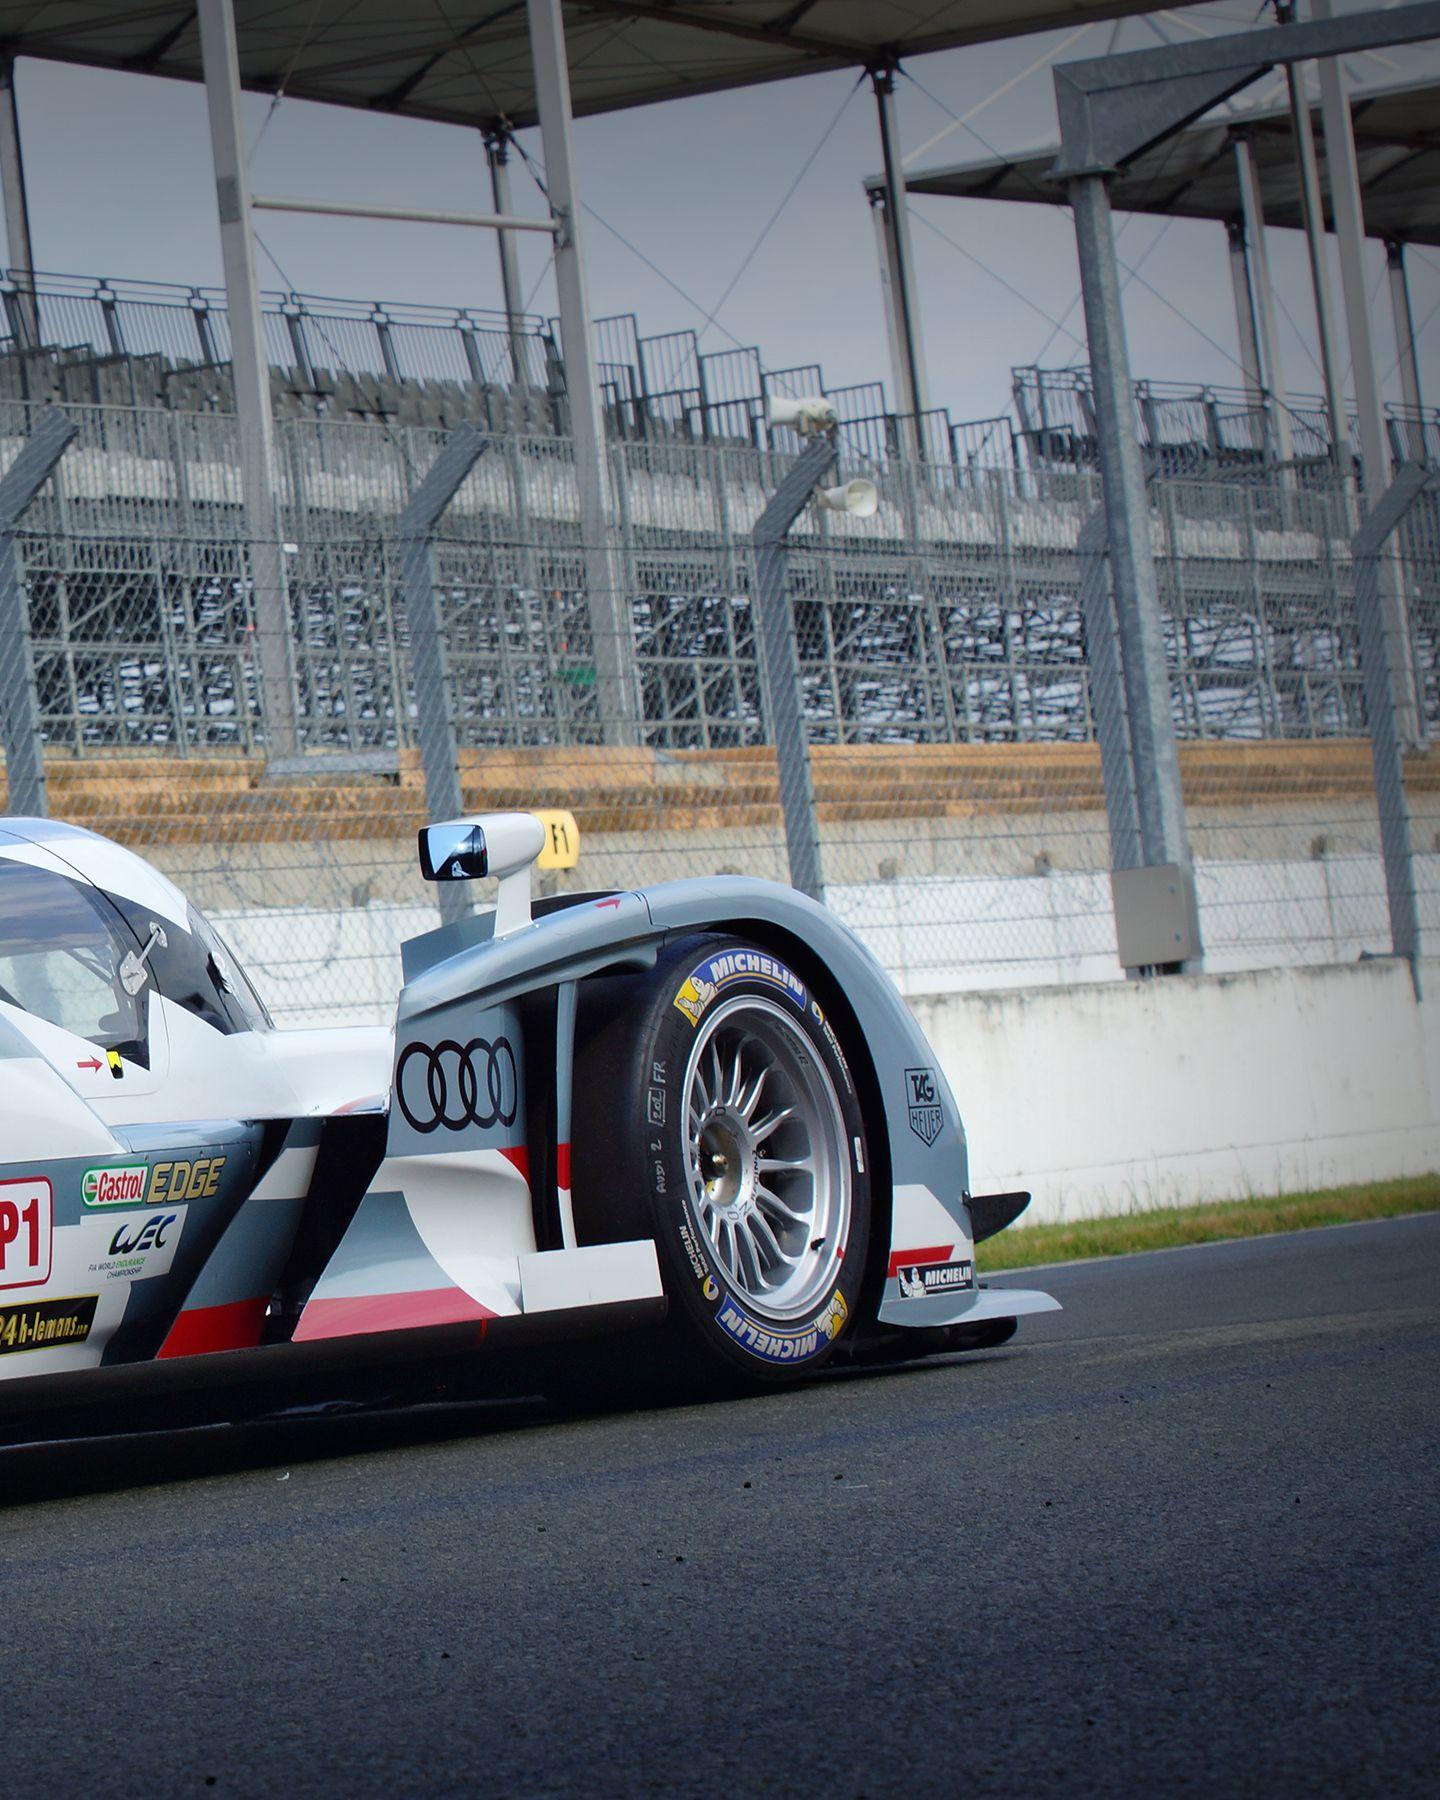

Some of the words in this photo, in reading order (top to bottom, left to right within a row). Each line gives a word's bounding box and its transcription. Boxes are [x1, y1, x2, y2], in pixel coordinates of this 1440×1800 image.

[710, 953, 803, 996] MICHELIN
[910, 1072, 935, 1102] TAG
[911, 1110, 942, 1140] HEUER
[98, 1170, 145, 1202] Castrol
[146, 1156, 228, 1204] EDGE
[108, 1214, 177, 1256] WEC
[679, 1225, 705, 1279] MICHELIN
[925, 1266, 972, 1286] MICHELIN
[720, 1307, 818, 1358] MICHELIN
